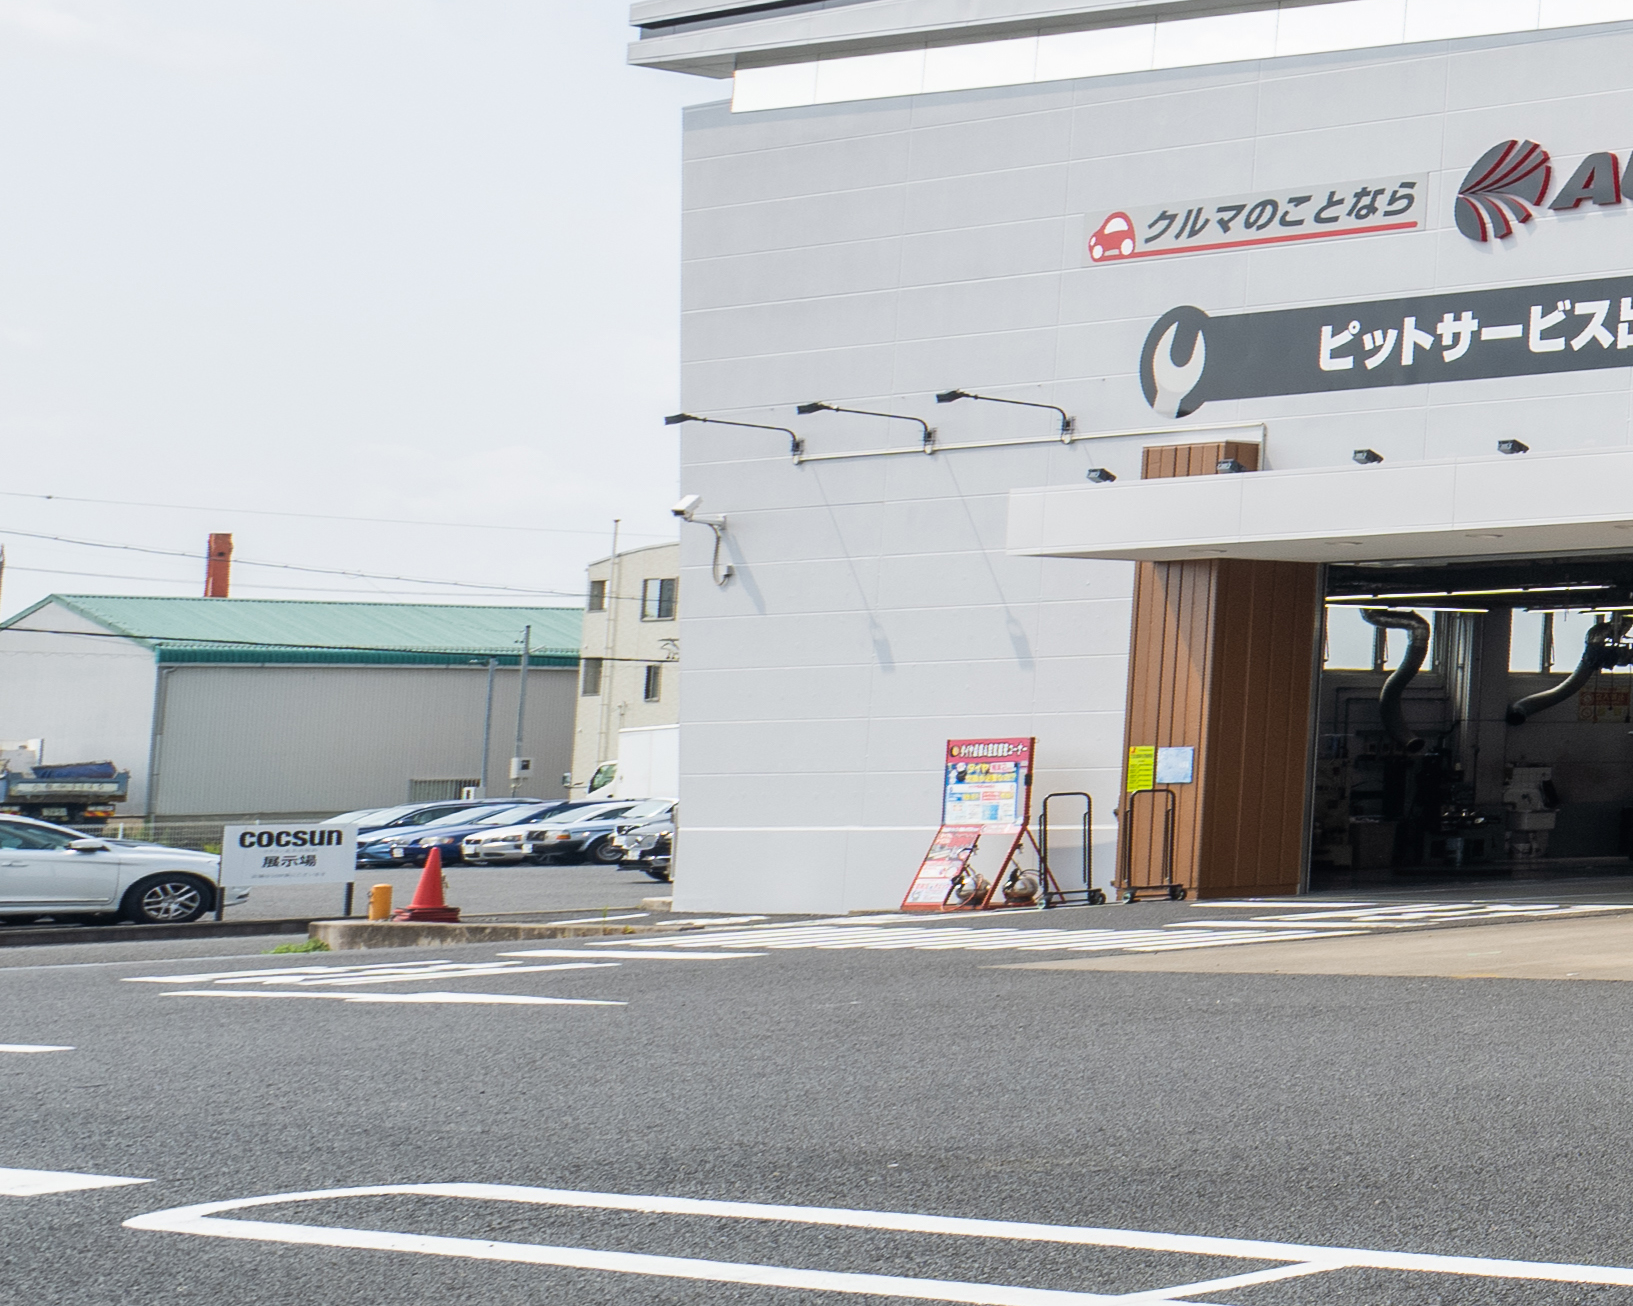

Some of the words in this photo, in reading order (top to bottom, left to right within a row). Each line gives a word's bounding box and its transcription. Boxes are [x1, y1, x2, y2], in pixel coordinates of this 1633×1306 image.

[1143, 180, 1417, 245] クルマのことなら
[239, 830, 343, 848] cocsun
[262, 855, 317, 868] 展示場
